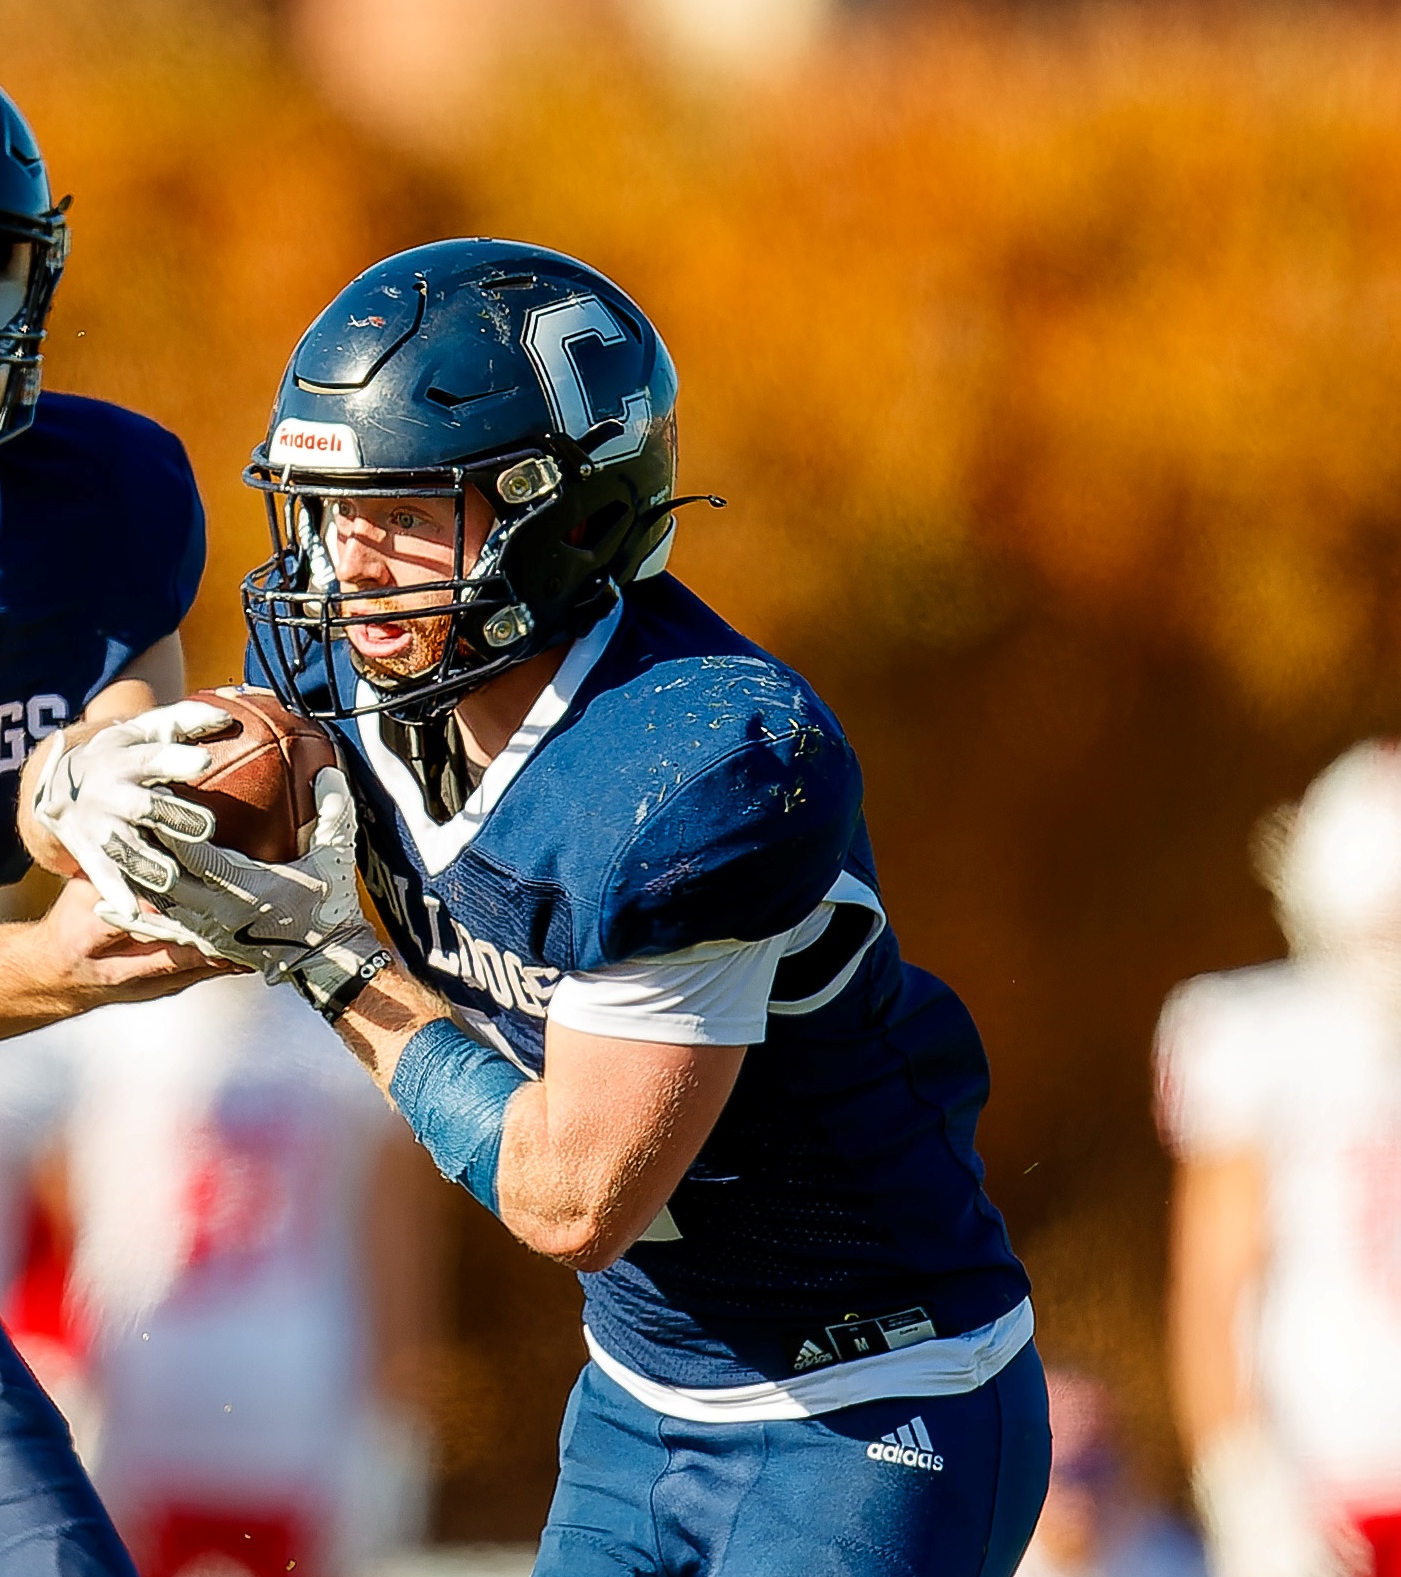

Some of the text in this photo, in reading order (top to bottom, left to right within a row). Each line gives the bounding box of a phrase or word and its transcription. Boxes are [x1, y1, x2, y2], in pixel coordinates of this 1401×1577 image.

[520, 293, 652, 468] C
[279, 427, 342, 452] Riddell
[853, 1336, 869, 1352] M
[866, 1442, 944, 1471] adidas
